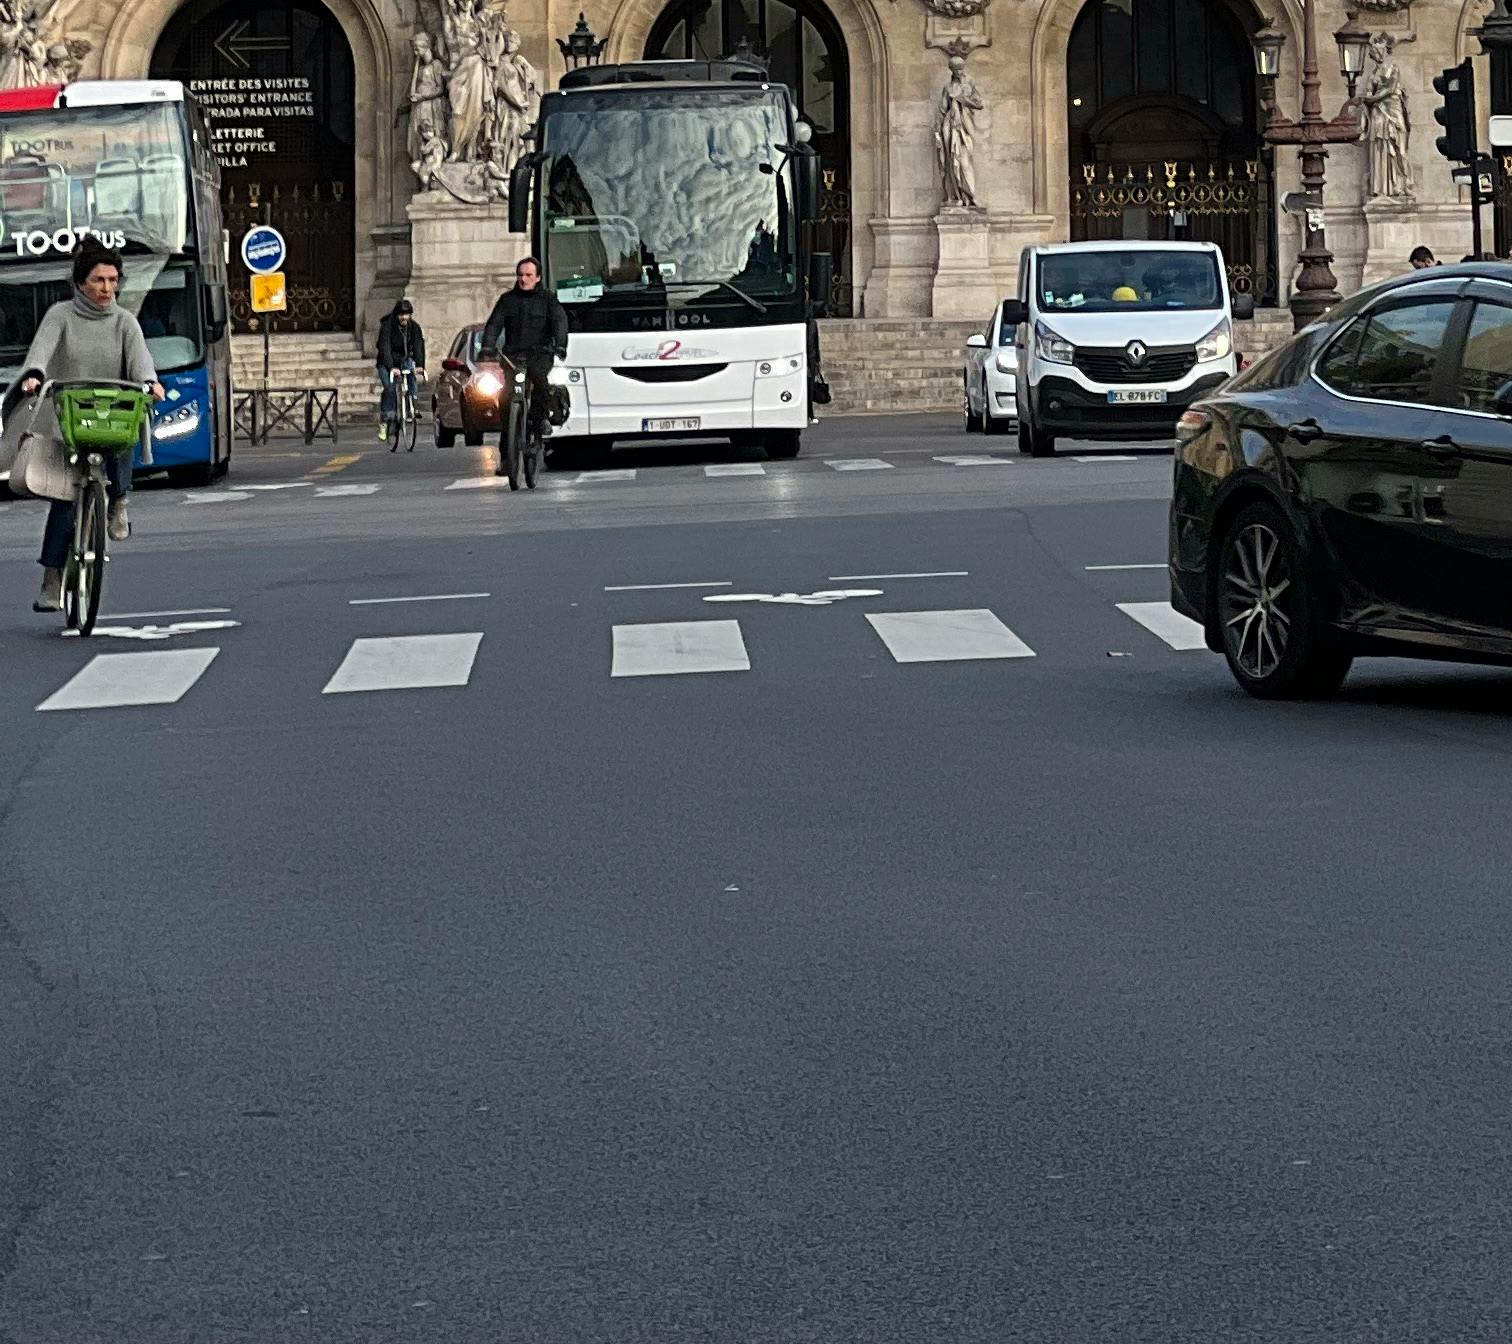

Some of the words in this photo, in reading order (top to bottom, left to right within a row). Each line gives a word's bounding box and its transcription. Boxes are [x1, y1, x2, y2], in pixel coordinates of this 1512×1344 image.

[190, 78, 236, 91] ENTRÉE
[239, 79, 262, 90] DES
[264, 78, 309, 89] VISITES
[250, 92, 313, 103] ENTRANCE
[243, 107, 272, 118] PARA
[273, 106, 314, 117] VISITAS
[211, 128, 265, 140] ETTERIE
[235, 141, 277, 152] OFFICE
[11, 226, 127, 256] TOOTUS
